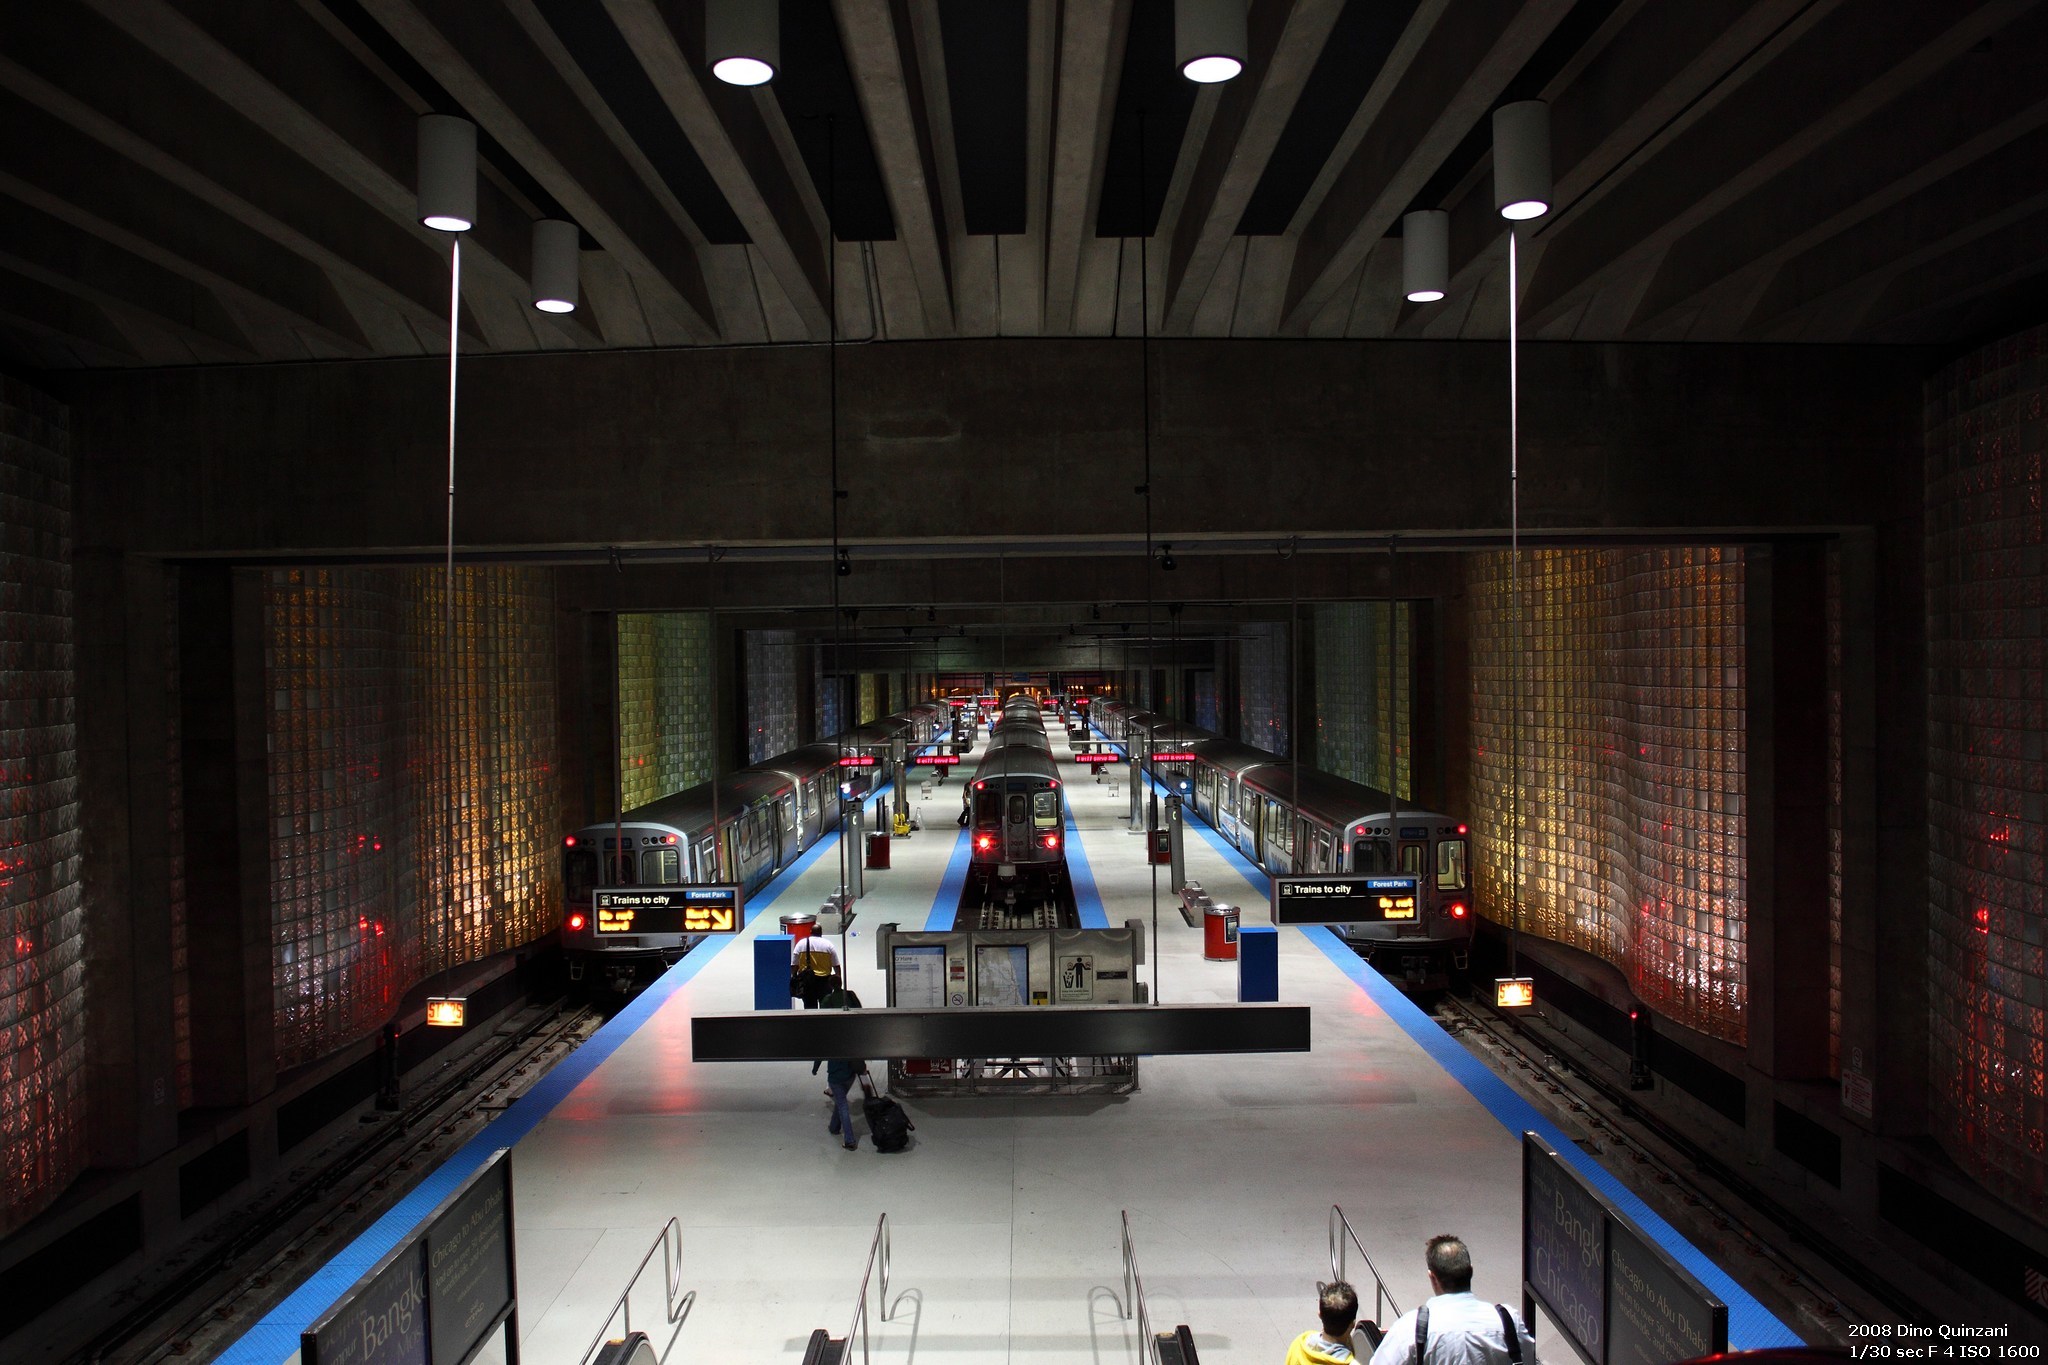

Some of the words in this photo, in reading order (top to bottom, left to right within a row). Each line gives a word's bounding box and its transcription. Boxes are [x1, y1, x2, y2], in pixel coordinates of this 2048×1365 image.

[1294, 884, 1322, 894] Trains
[1324, 885, 1332, 894] to
[1334, 884, 1352, 896] city
[1373, 880, 1392, 888] Forest
[612, 896, 640, 904] Trains
[642, 896, 652, 904] to
[653, 896, 670, 906] city
[1500, 982, 1532, 999] STRS
[428, 1002, 462, 1019] STRS
[1555, 1189, 1601, 1267] Bangk
[432, 1232, 462, 1269] Chicago
[462, 1224, 470, 1238] to
[470, 1210, 484, 1229] Abu
[1536, 1246, 1599, 1346] Chicago
[1611, 1248, 1644, 1292] Chicago
[1646, 1284, 1655, 1303] to
[1656, 1295, 1676, 1323] Abu
[1678, 1313, 1707, 1356] Dhabi
